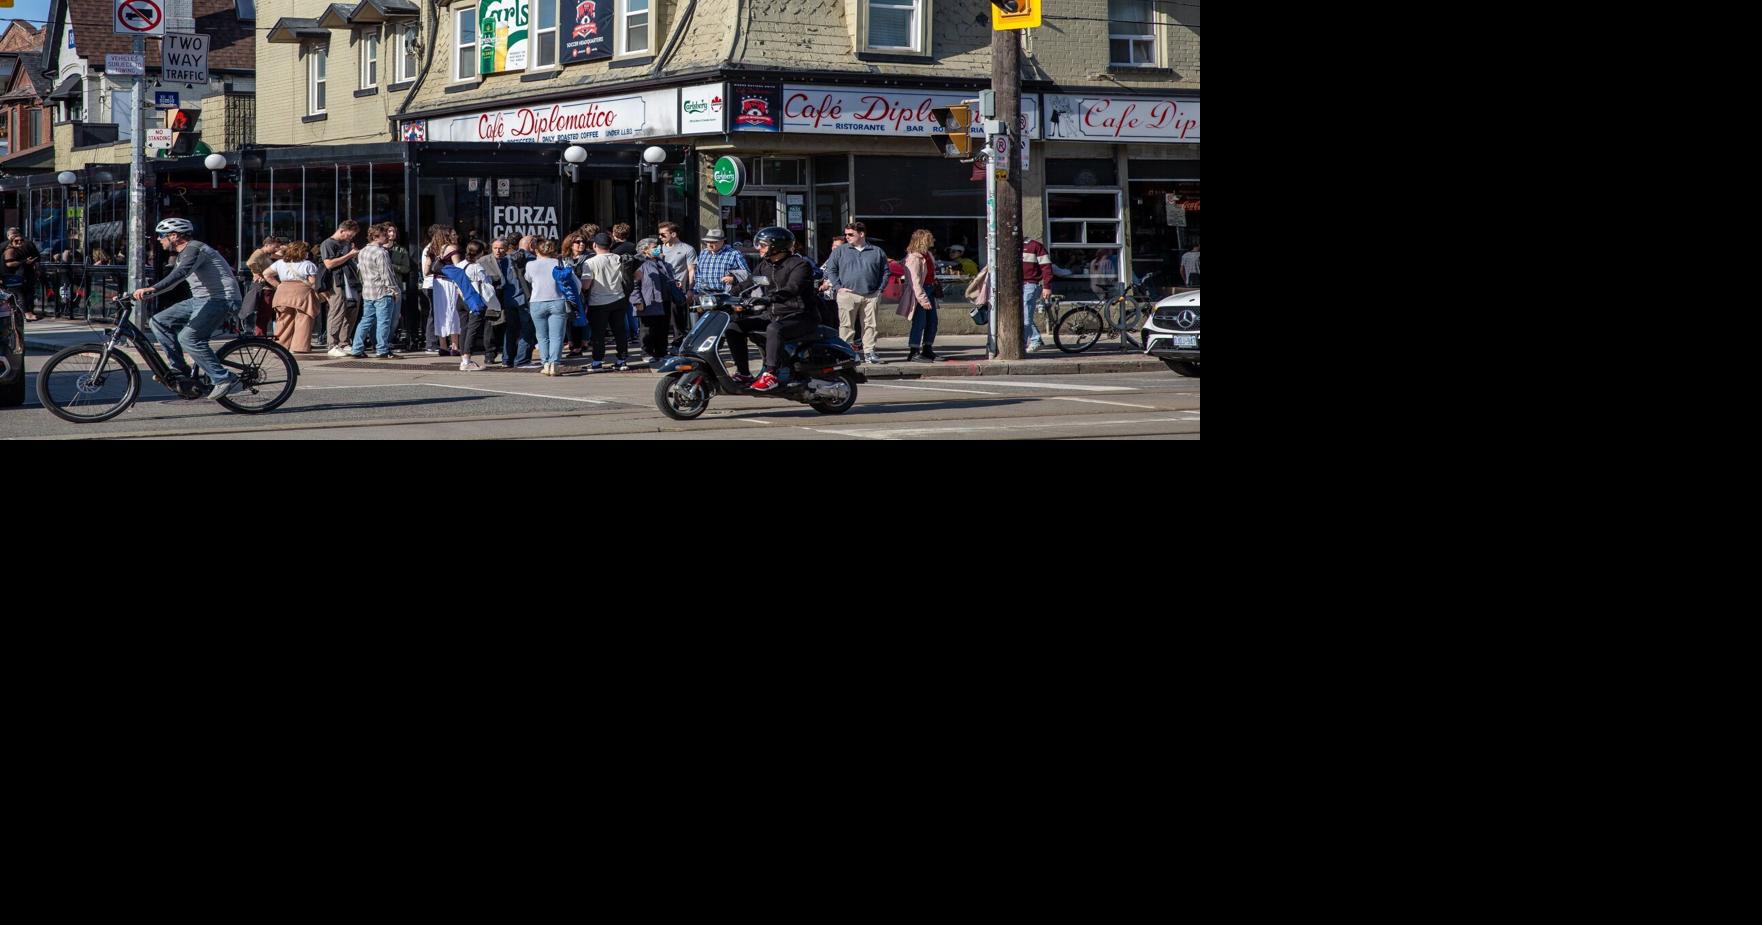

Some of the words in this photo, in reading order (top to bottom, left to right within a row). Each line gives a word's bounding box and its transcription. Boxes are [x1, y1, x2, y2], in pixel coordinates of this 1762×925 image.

[169, 36, 202, 50] TWO
[168, 53, 202, 67] WAY
[166, 69, 204, 81] TRAFFIC
[683, 99, 708, 114] Carlsberg
[511, 103, 618, 143] Diplomatico
[1084, 99, 1144, 137] Cafe
[835, 124, 885, 132] RISTORANTE
[542, 135, 556, 143] DAILY
[557, 133, 579, 141] ROASTED
[580, 131, 600, 139] COFFEE
[714, 167, 735, 183] Carlsberg
[494, 206, 558, 224] FORZA
[494, 225, 559, 241] CANADA
